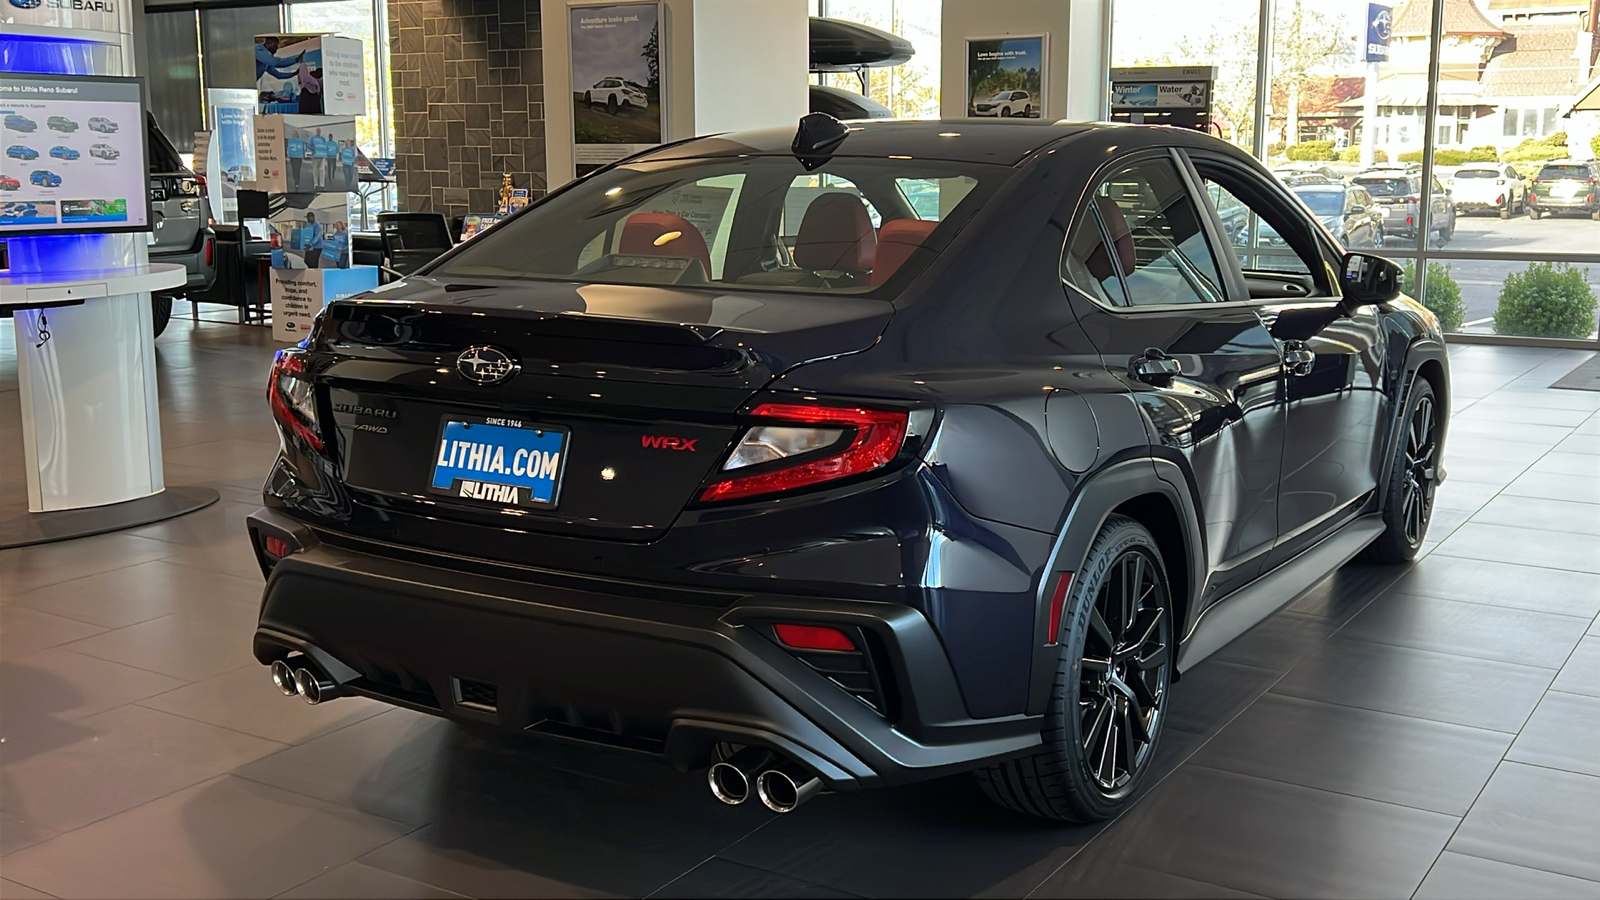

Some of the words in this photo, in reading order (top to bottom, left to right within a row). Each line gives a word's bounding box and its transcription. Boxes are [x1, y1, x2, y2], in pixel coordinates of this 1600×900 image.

[46, 0, 114, 13] SUBARU
[608, 15, 623, 23] looks
[623, 14, 640, 24] good.
[21, 85, 38, 93] Lithia
[1114, 86, 1142, 94] Winter
[1160, 85, 1183, 93] Water
[275, 278, 296, 286] Providing
[297, 280, 317, 288] comfort,
[333, 403, 398, 419] SUBARU
[485, 417, 506, 426] SINCE
[507, 419, 522, 428] 1946
[356, 424, 388, 434] AWD
[641, 434, 699, 452] WRX
[437, 439, 560, 481] LITHIA.COM
[472, 481, 519, 505] LITHIA
[1078, 546, 1113, 633] DUNLOP
